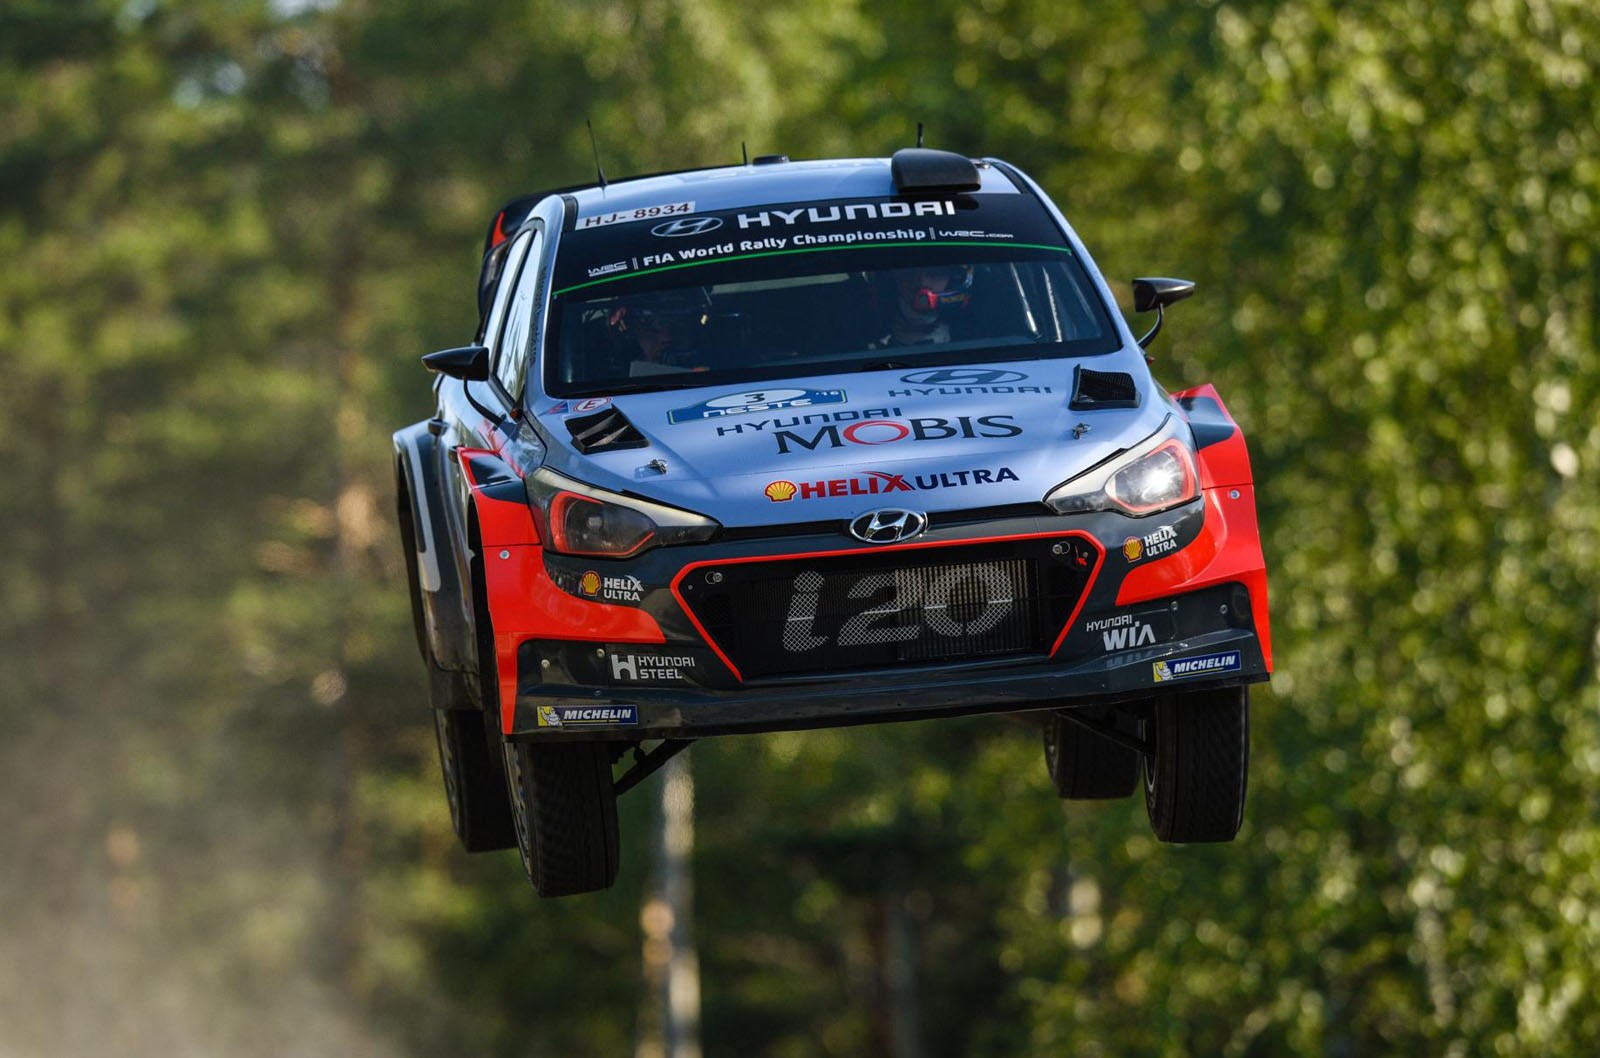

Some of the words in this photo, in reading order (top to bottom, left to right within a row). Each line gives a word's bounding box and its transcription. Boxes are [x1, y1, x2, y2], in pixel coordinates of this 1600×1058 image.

[633, 203, 690, 219] 8934
[737, 201, 956, 228] HYUNDAI
[643, 253, 675, 267] FIA
[678, 243, 733, 260] World
[740, 238, 787, 251] Rally
[793, 228, 926, 245] Championship
[744, 392, 766, 404] 3
[888, 386, 1052, 398] HYUNDAI
[703, 398, 813, 418] NESTE
[716, 407, 902, 437] HYUNDAI
[772, 415, 1023, 454] MOBIS
[799, 470, 912, 499] HELIX
[913, 467, 1020, 491] ULTRA
[1143, 525, 1178, 547] HELIX
[1145, 539, 1177, 557] ULTRA
[603, 574, 645, 592] HELIX
[603, 589, 641, 602] ULTRA
[1086, 614, 1133, 632] HYUNDAI
[1103, 621, 1157, 651] WIA
[638, 655, 696, 668] HYUNDAI
[1173, 654, 1236, 674] MICHELIN
[639, 668, 683, 680] STEEL
[563, 708, 632, 720] MICHELIN
